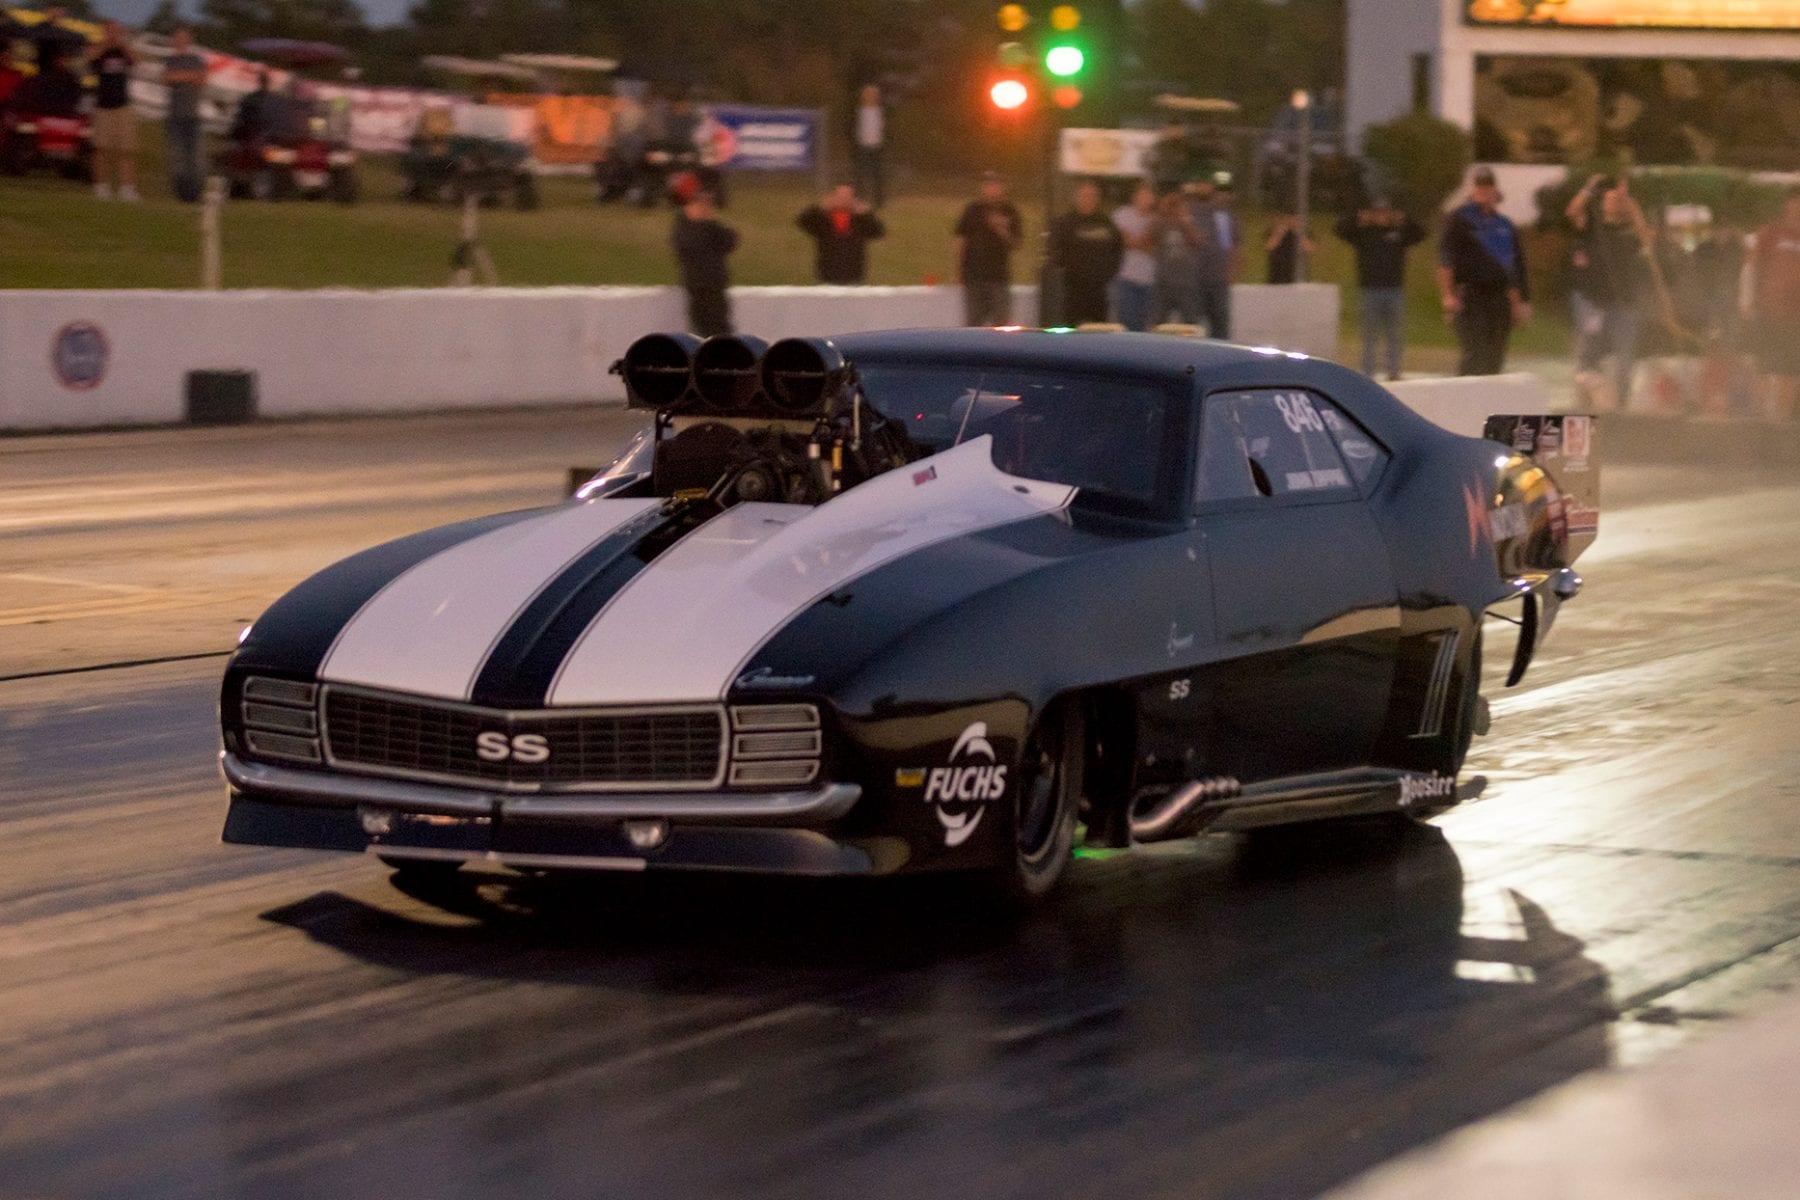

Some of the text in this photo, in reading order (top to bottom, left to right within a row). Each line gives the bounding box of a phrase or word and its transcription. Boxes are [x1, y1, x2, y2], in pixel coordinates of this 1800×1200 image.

[1169, 678, 1191, 700] SS
[476, 731, 551, 763] SS
[924, 764, 1008, 803] FUCHS
